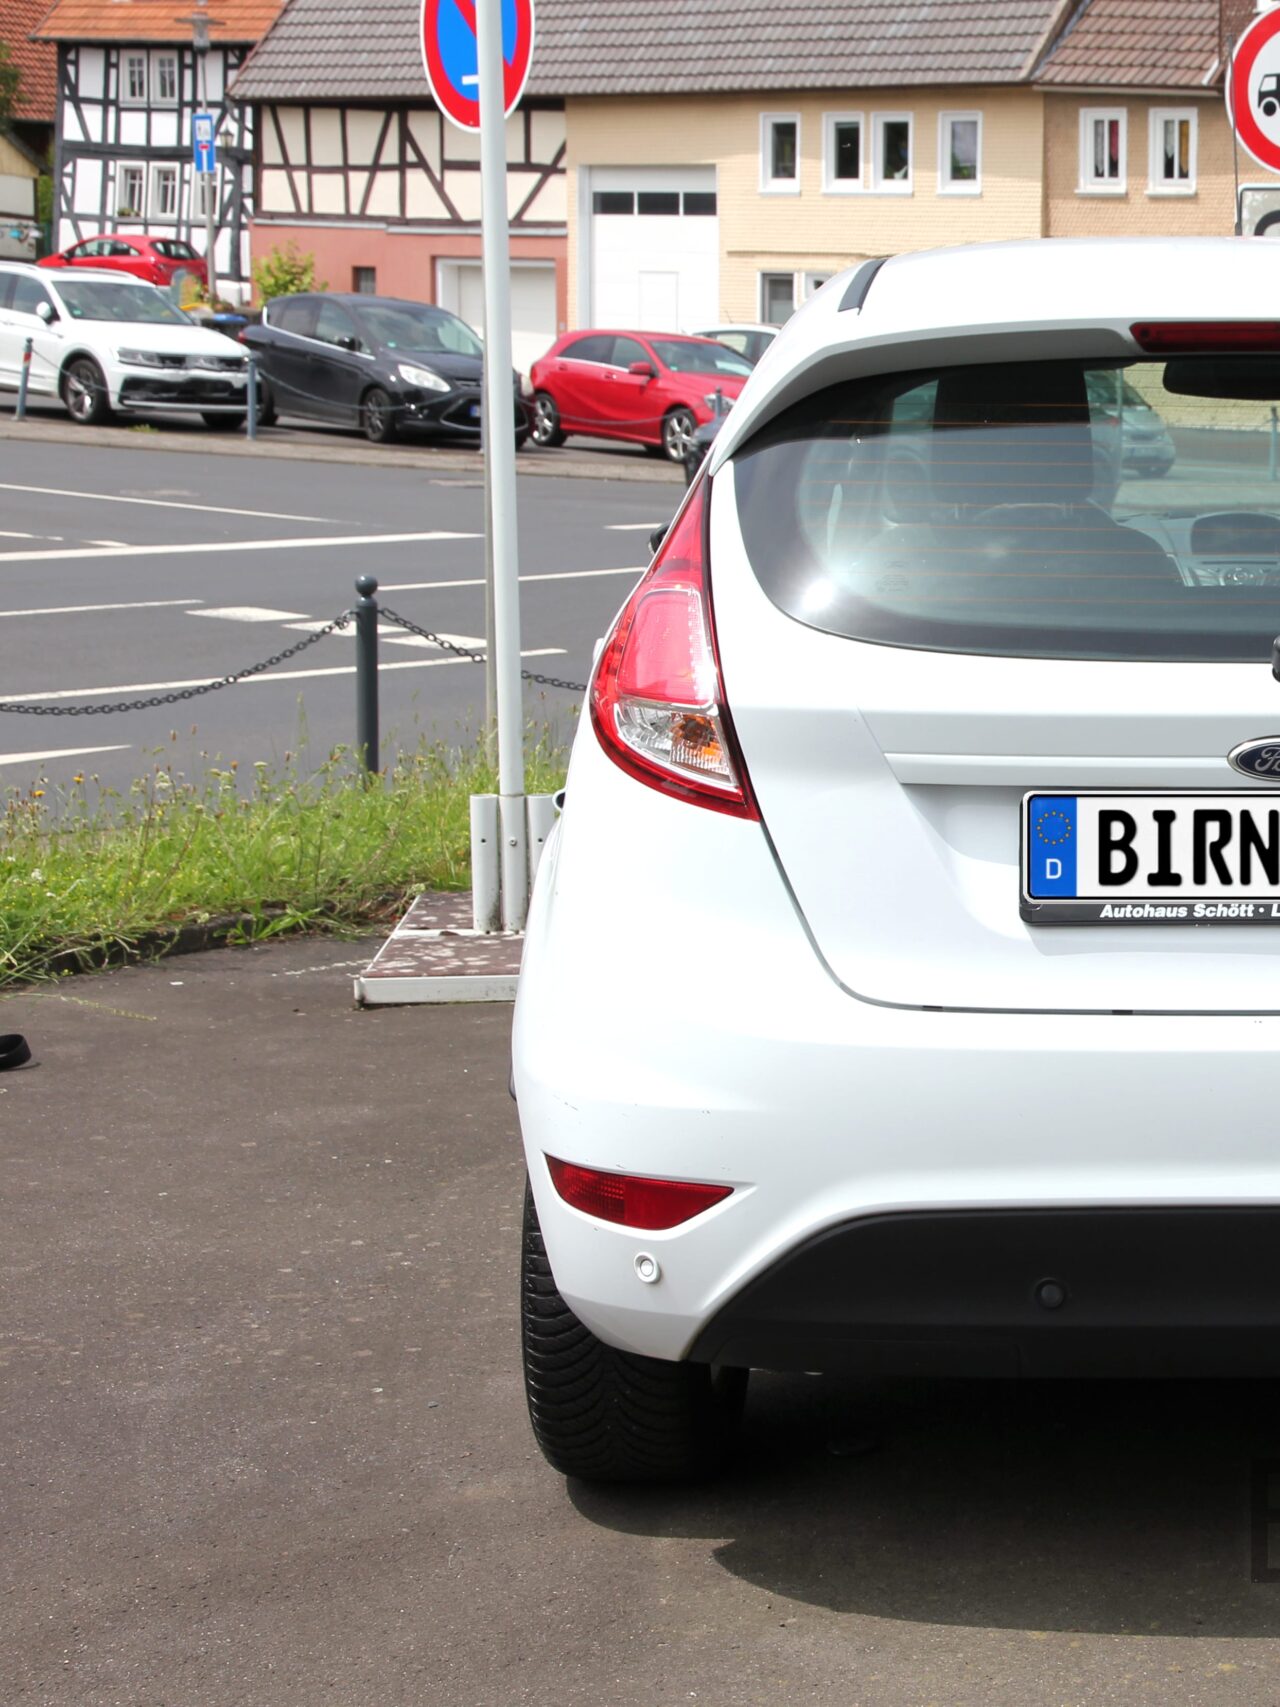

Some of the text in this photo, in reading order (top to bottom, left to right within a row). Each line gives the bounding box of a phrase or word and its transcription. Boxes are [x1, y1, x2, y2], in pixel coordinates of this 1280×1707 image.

[1045, 858, 1063, 880] D
[1099, 903, 1188, 919] Autohaus
[1192, 902, 1255, 919] Schött
